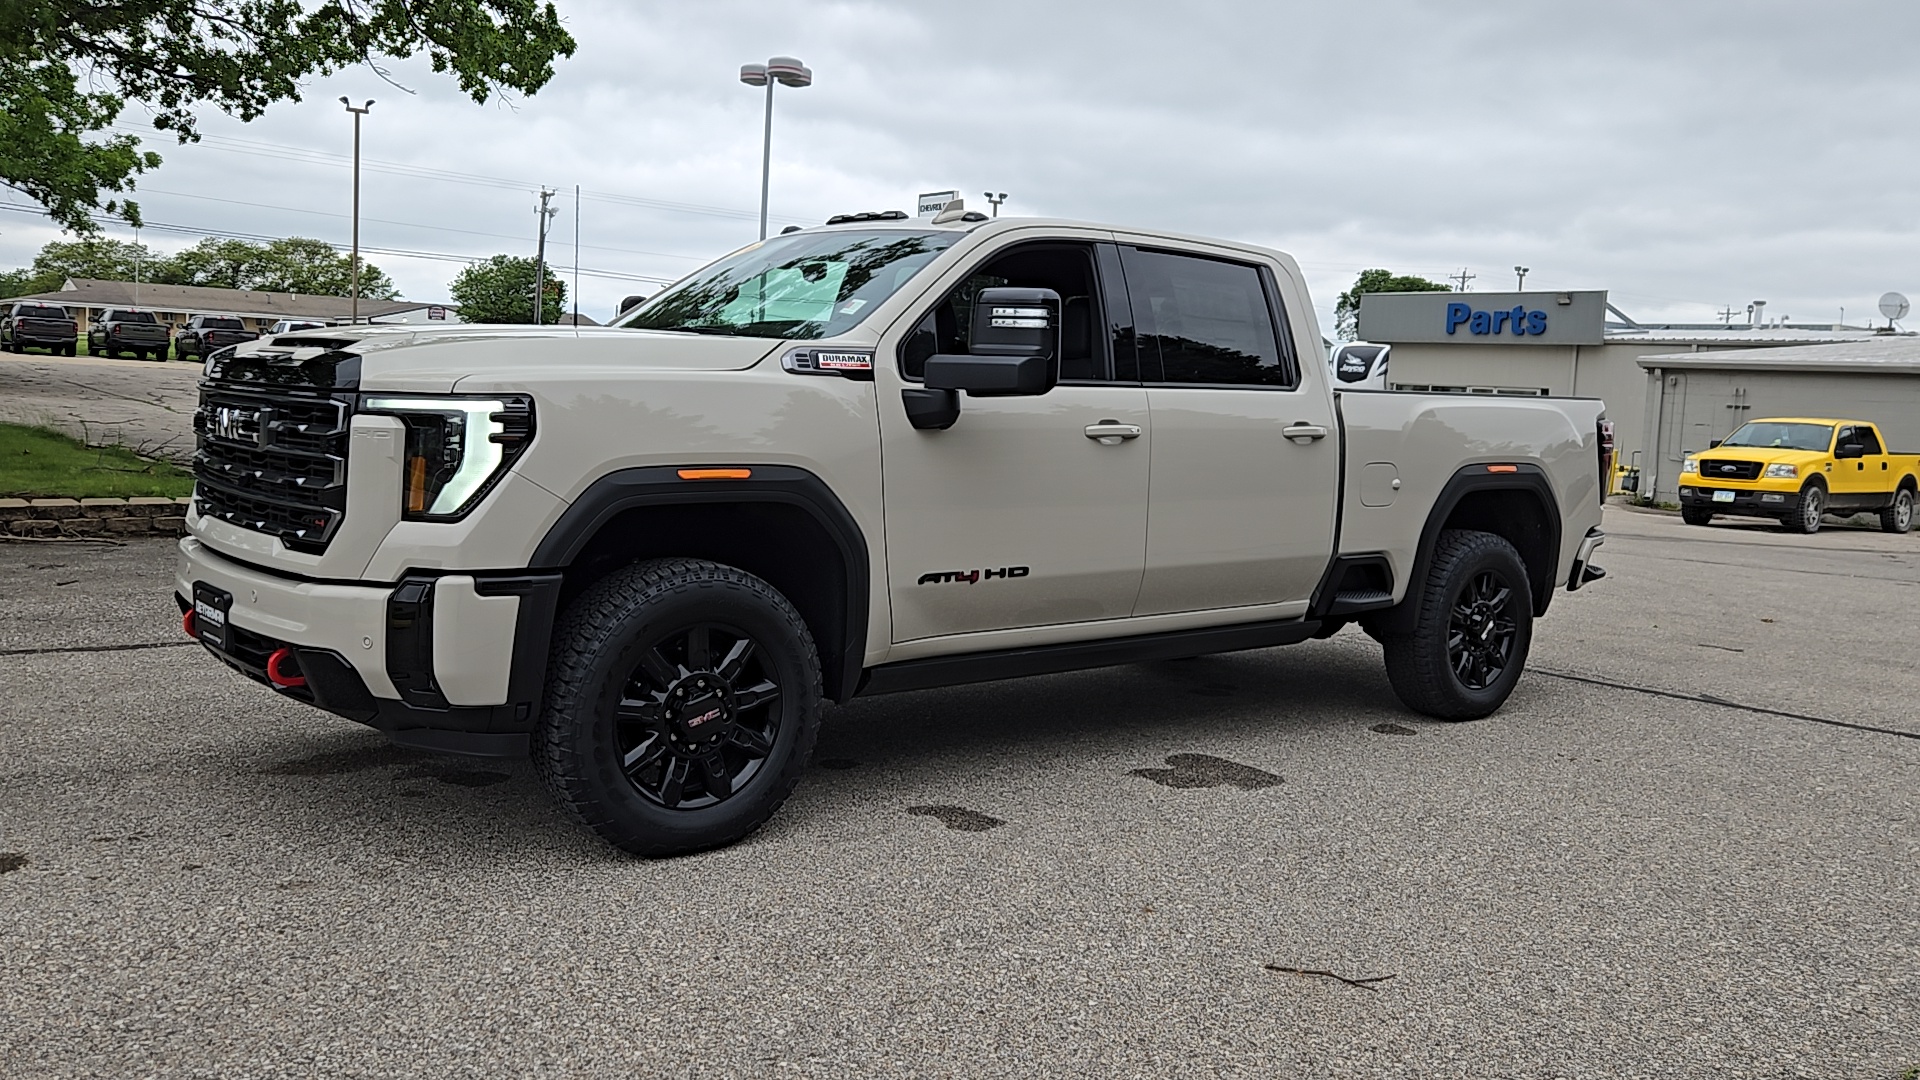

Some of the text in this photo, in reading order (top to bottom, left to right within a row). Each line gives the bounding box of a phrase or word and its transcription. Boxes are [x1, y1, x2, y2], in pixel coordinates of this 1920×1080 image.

[1446, 303, 1547, 336] Parts
[822, 354, 868, 363] DURAMAX
[918, 566, 1030, 585] AT4 HD
[687, 708, 721, 728] GMC
